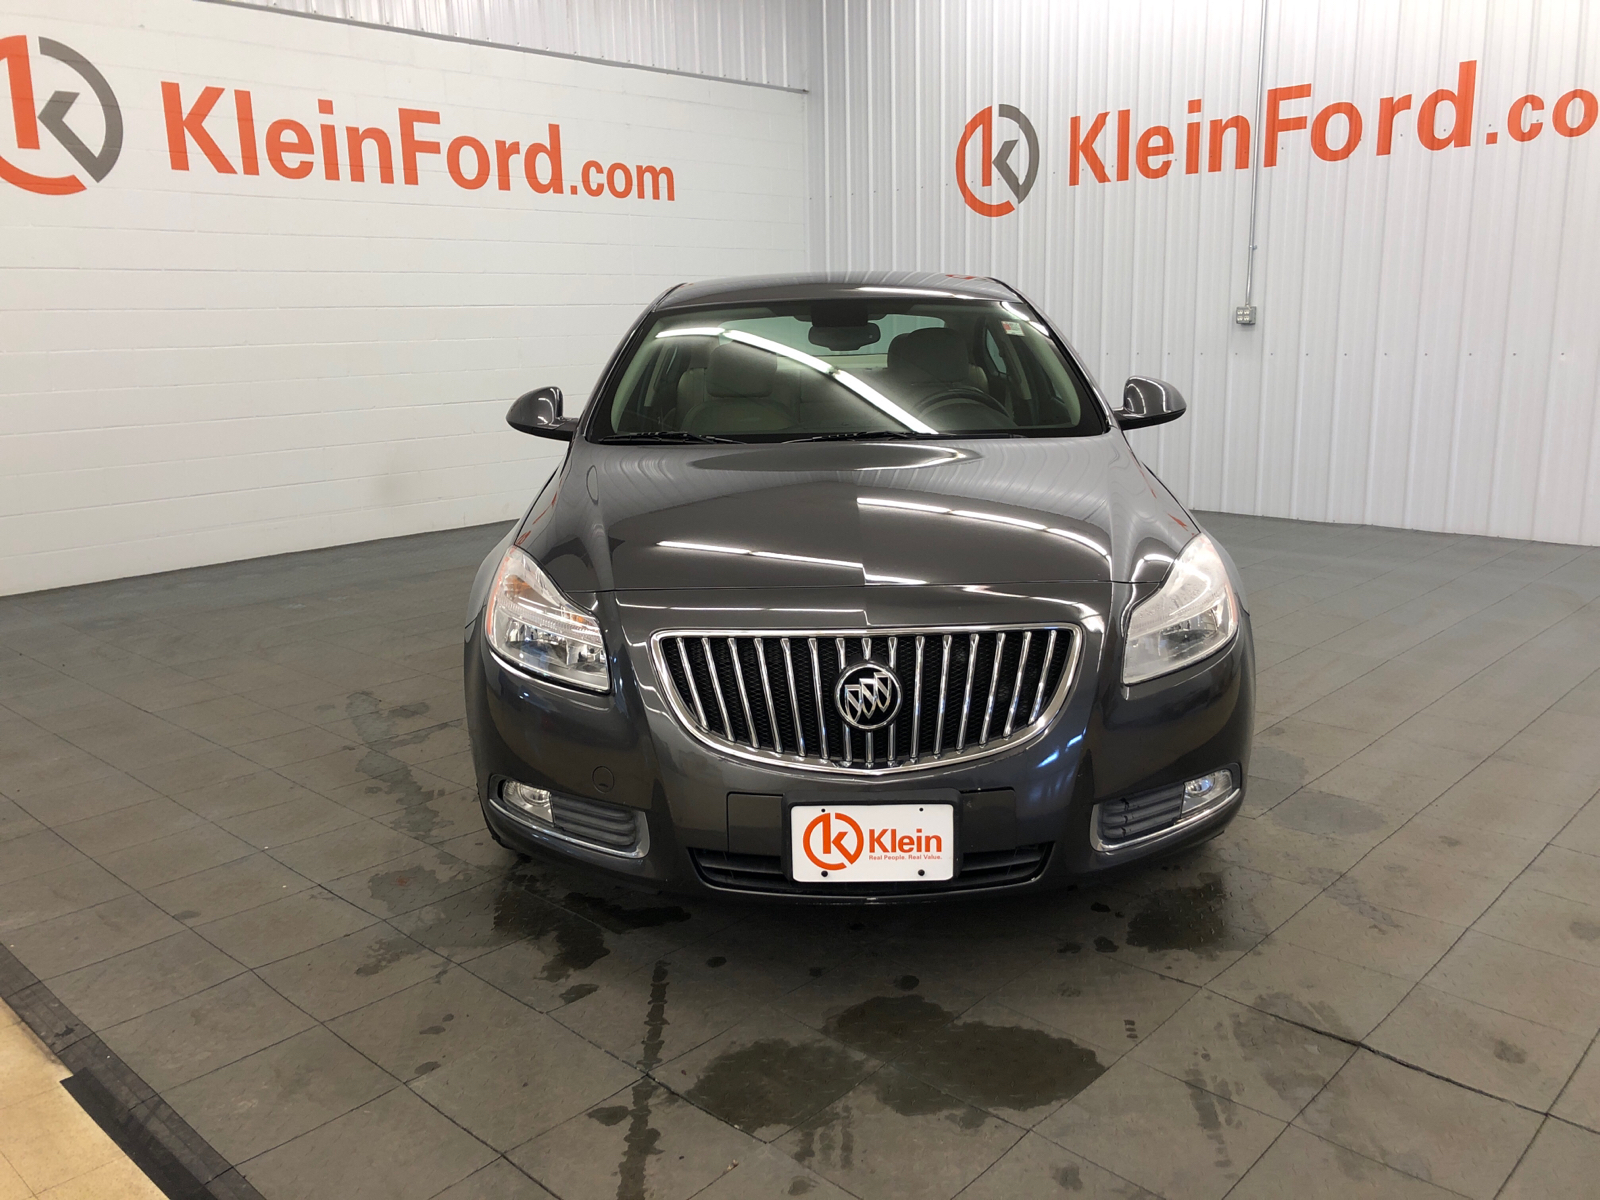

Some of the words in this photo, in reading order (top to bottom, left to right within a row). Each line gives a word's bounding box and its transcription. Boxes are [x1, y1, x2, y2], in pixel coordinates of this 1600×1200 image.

[160, 80, 676, 202] KleinFord.com
[1068, 59, 1599, 187] KleinFord.co
[868, 828, 943, 853] Klein
